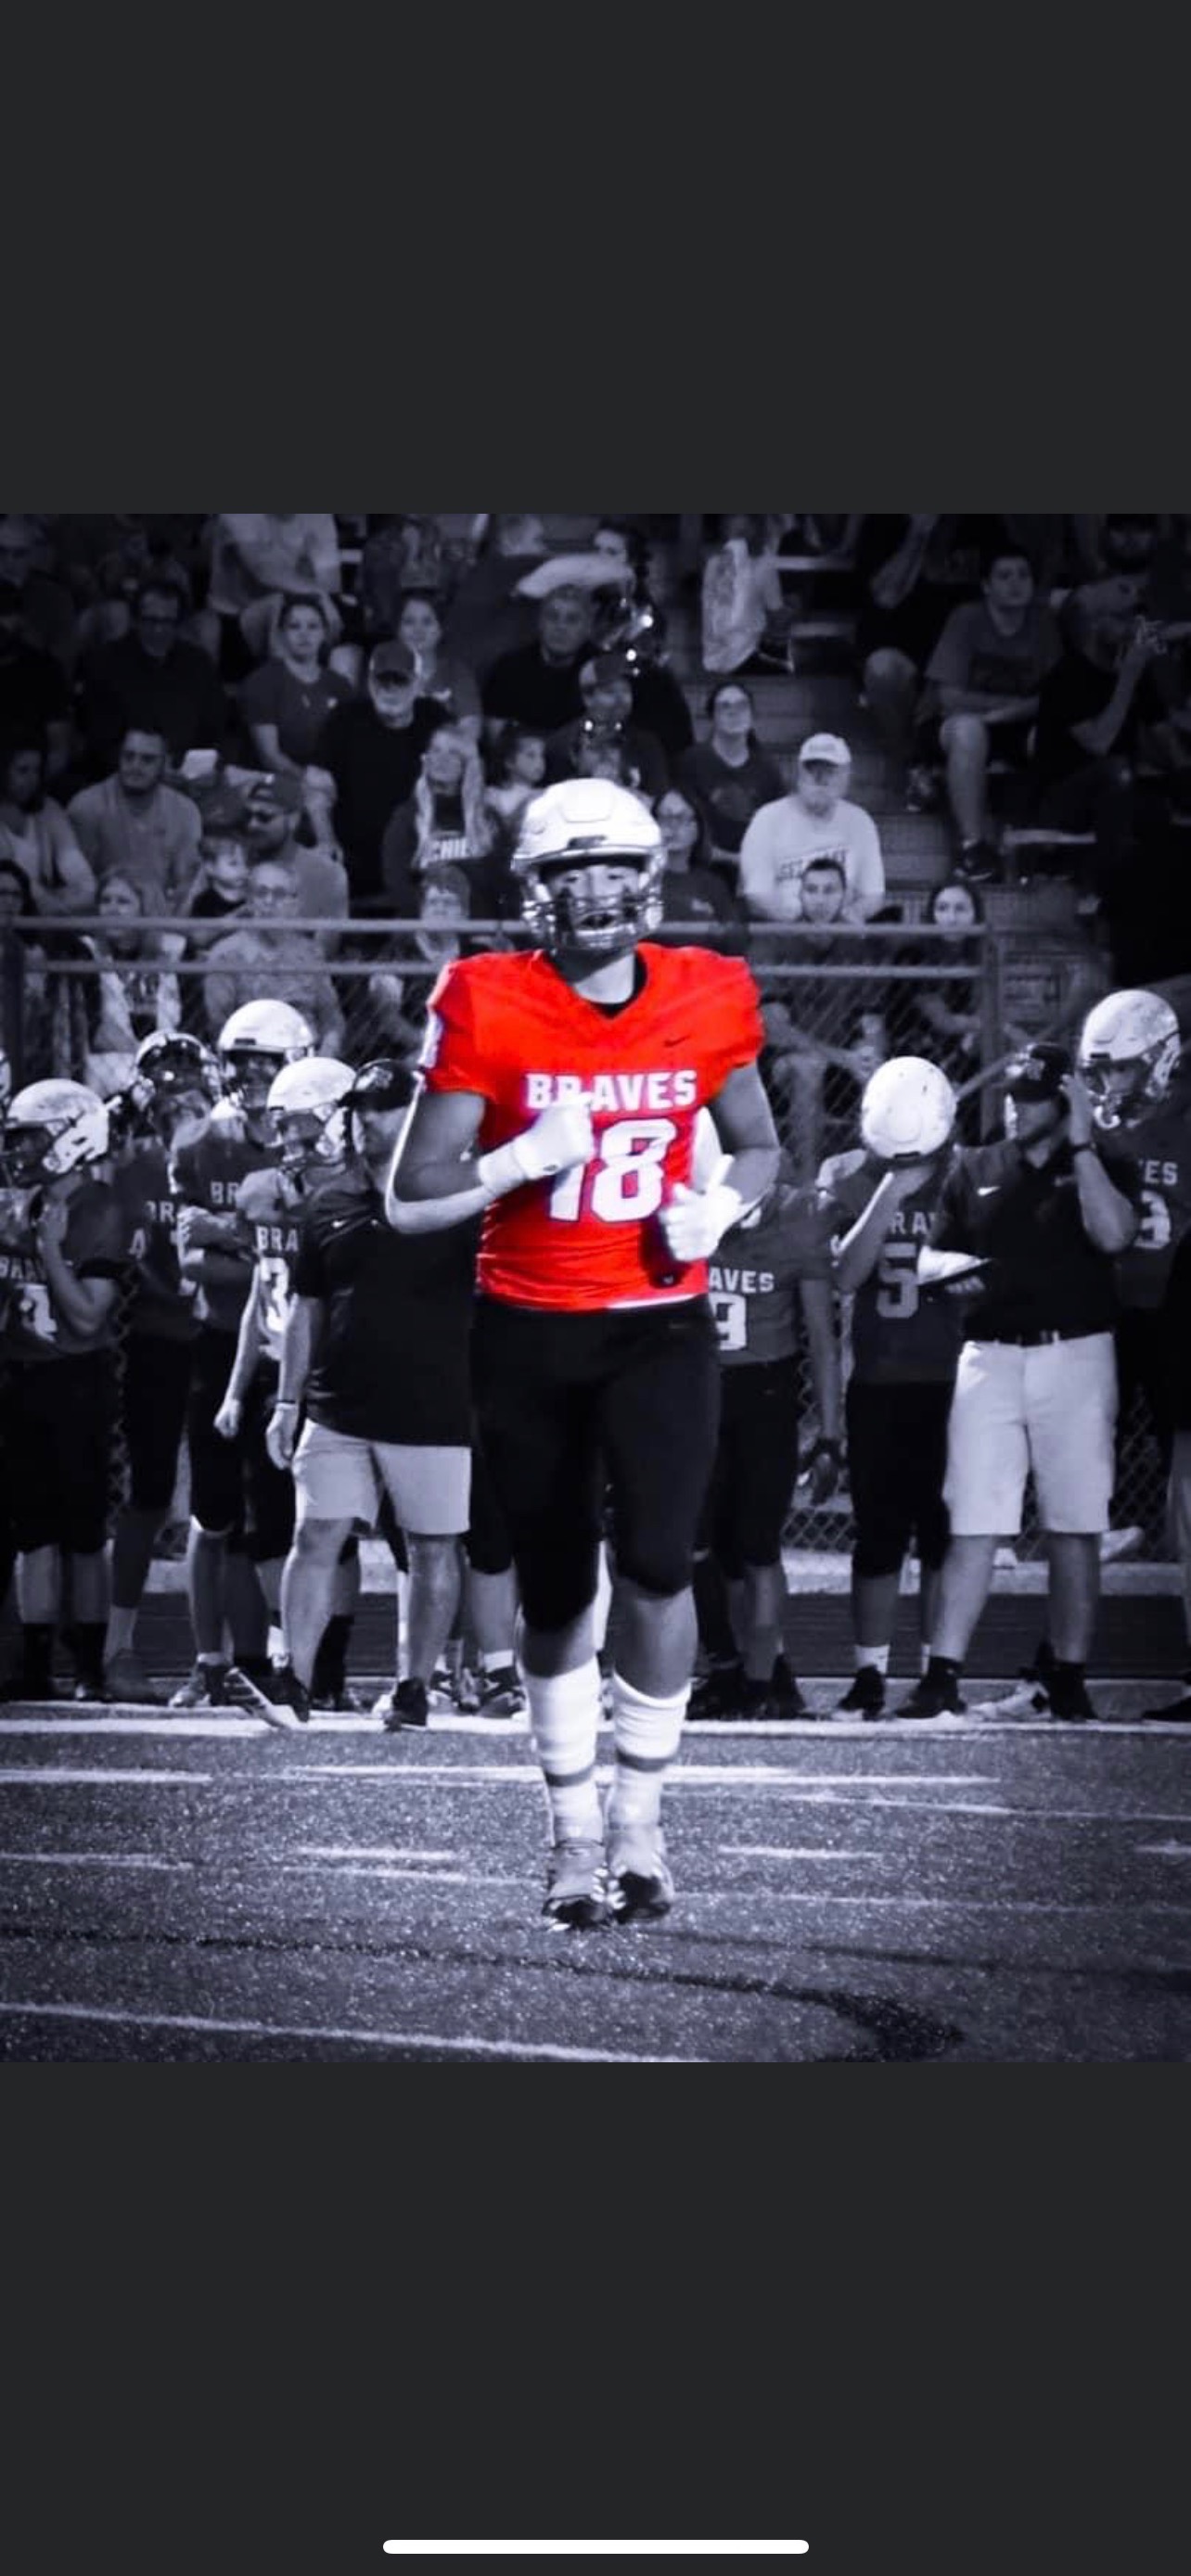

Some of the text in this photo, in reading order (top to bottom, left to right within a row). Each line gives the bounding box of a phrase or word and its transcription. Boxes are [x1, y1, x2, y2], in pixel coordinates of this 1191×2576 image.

[526, 1070, 697, 1112] BRAVES
[549, 1118, 677, 1223] 18
[877, 1243, 918, 1319] 5
